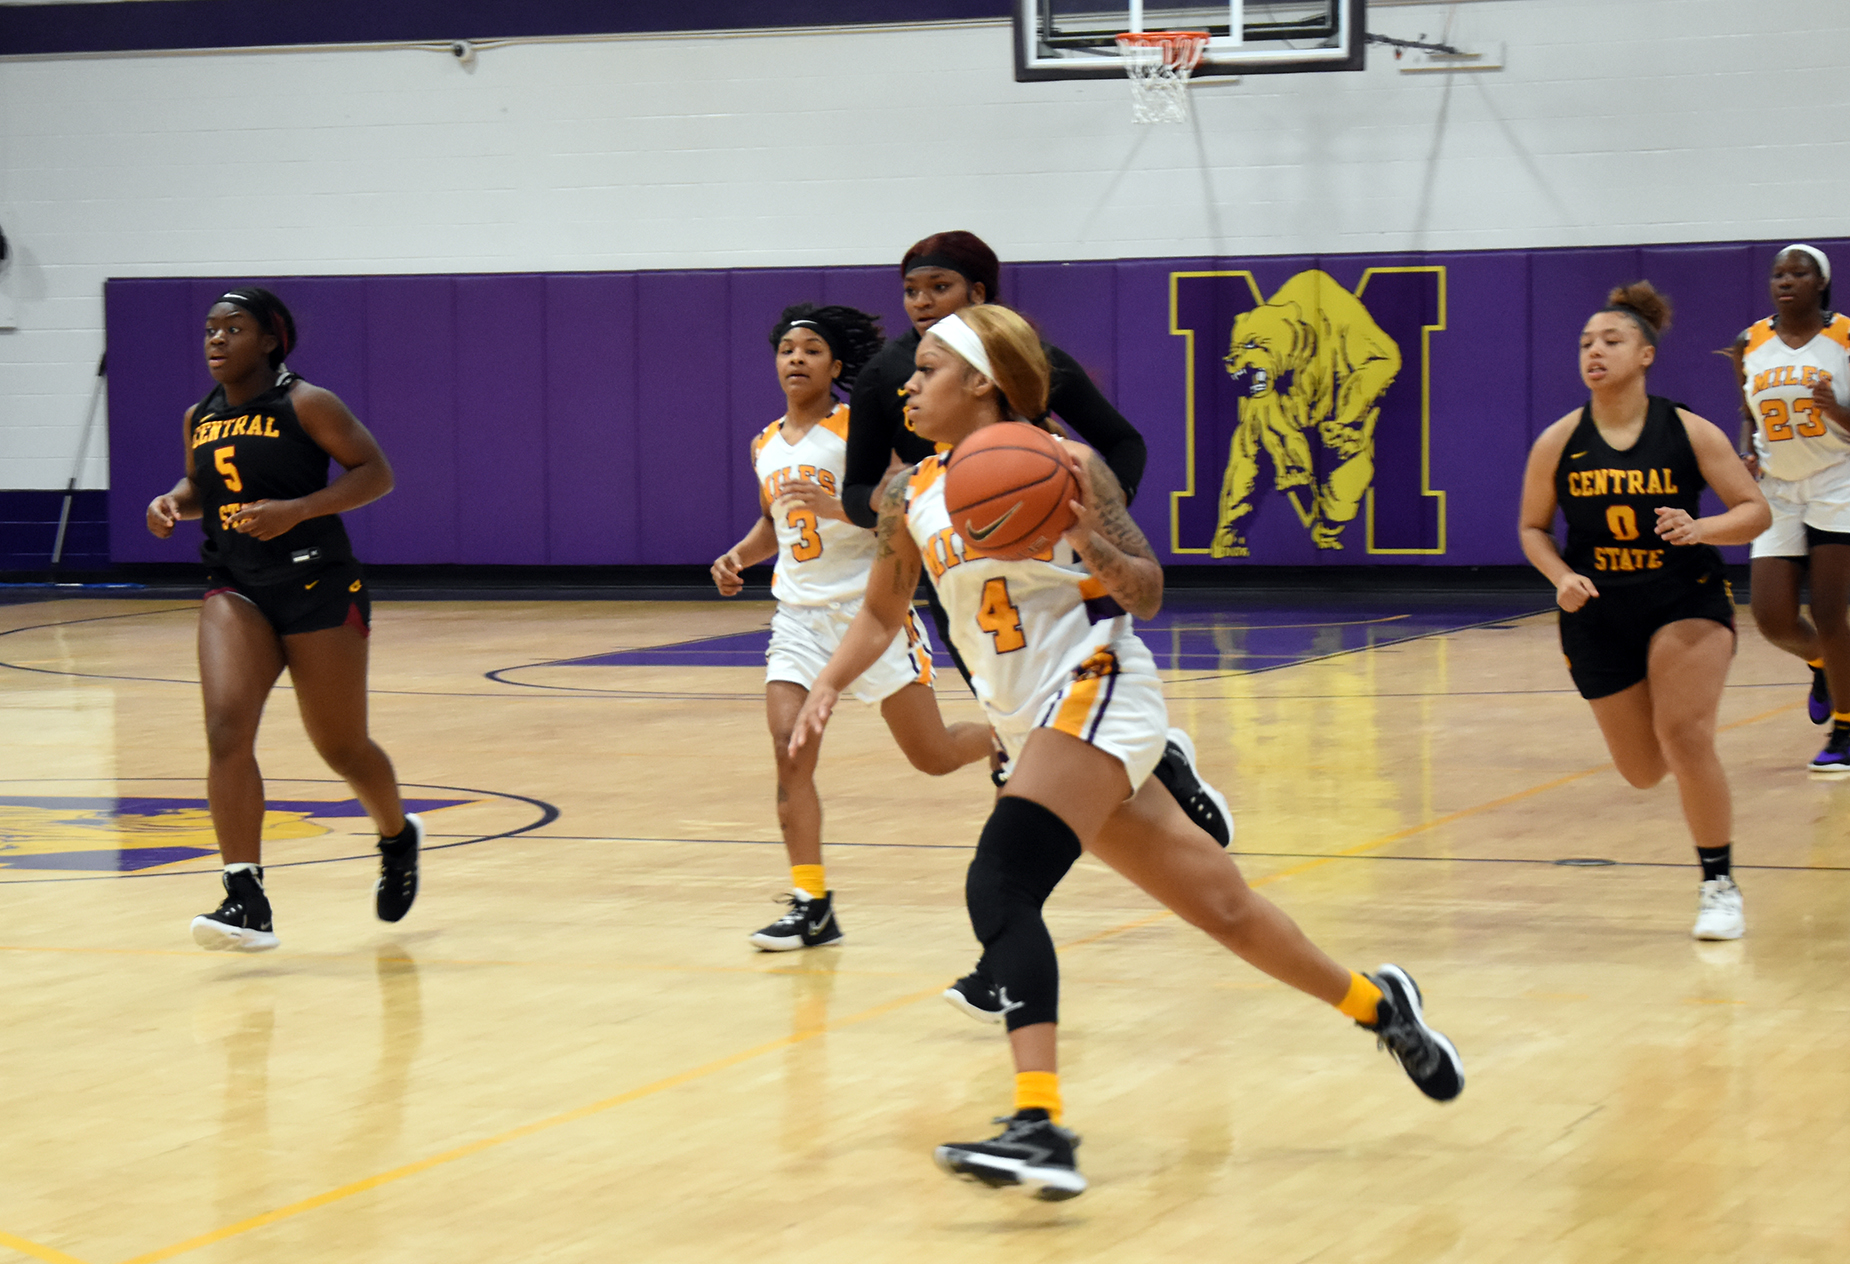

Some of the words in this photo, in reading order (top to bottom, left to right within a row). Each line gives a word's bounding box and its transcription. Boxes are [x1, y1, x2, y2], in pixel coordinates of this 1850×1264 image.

[192, 414, 280, 449] CENTRAL
[1759, 398, 1827, 441] 23
[213, 445, 243, 493] 5
[1567, 467, 1678, 498] CENTRAL
[786, 509, 823, 562] 3
[1593, 547, 1664, 572] STATE
[976, 576, 1028, 655] 4
